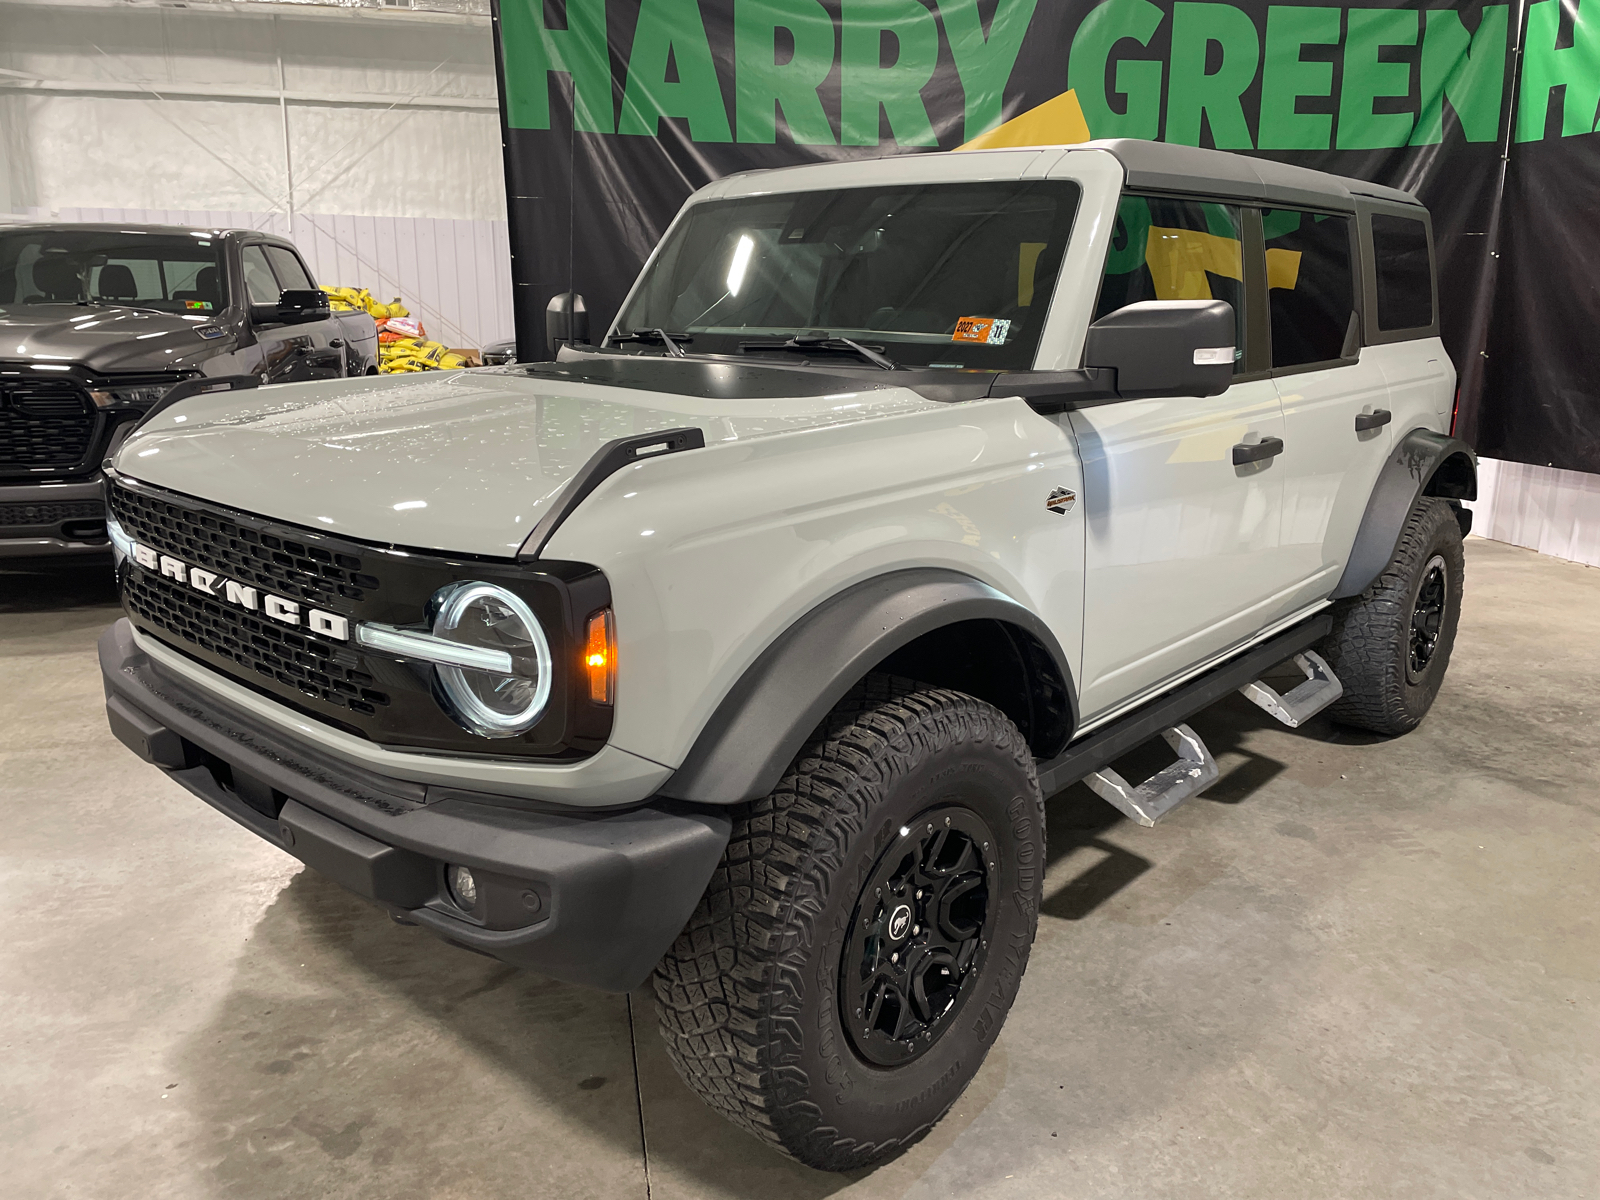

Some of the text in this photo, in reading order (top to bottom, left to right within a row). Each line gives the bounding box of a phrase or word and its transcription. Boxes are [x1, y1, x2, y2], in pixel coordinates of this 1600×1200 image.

[500, 0, 1508, 150] HARRY GREEN
[1514, 0, 1600, 143] H
[956, 321, 973, 333] 2027
[135, 543, 349, 641] BRONCO
